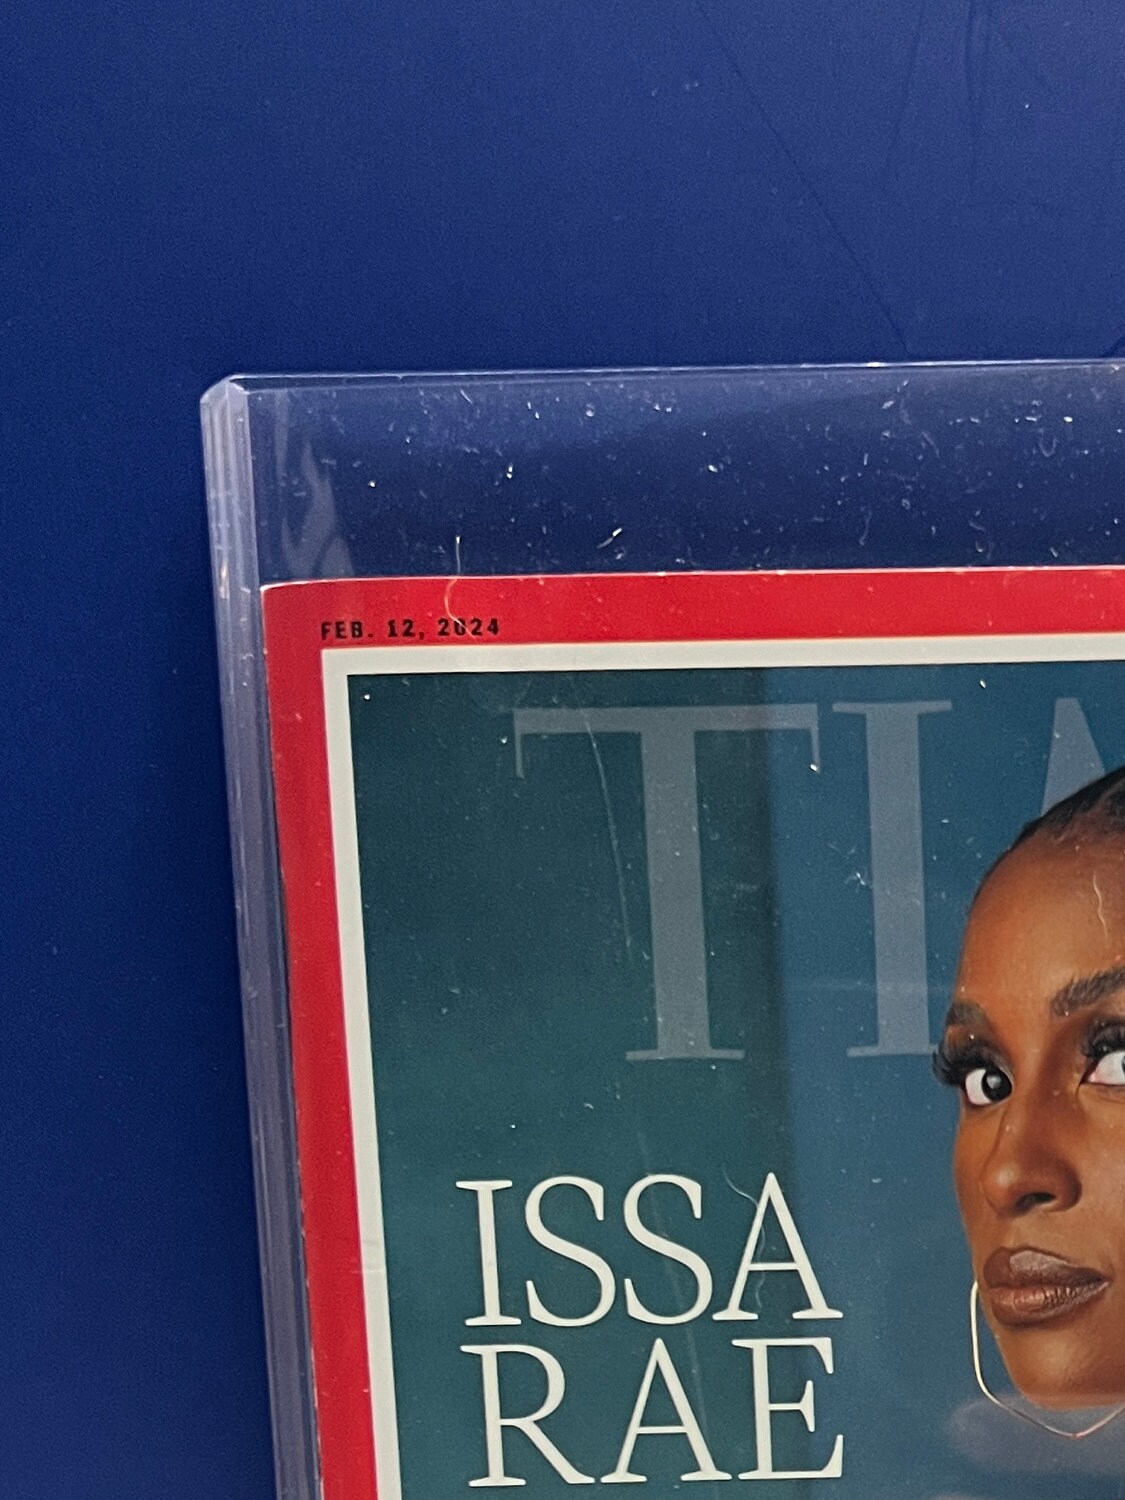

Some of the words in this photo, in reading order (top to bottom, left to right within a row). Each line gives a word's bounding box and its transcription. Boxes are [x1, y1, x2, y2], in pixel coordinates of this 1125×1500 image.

[321, 621, 374, 640] FEB.
[387, 619, 425, 640] 12,
[437, 618, 500, 636] 2024
[456, 1172, 844, 1327] ISSA
[460, 1337, 844, 1487] RAE
